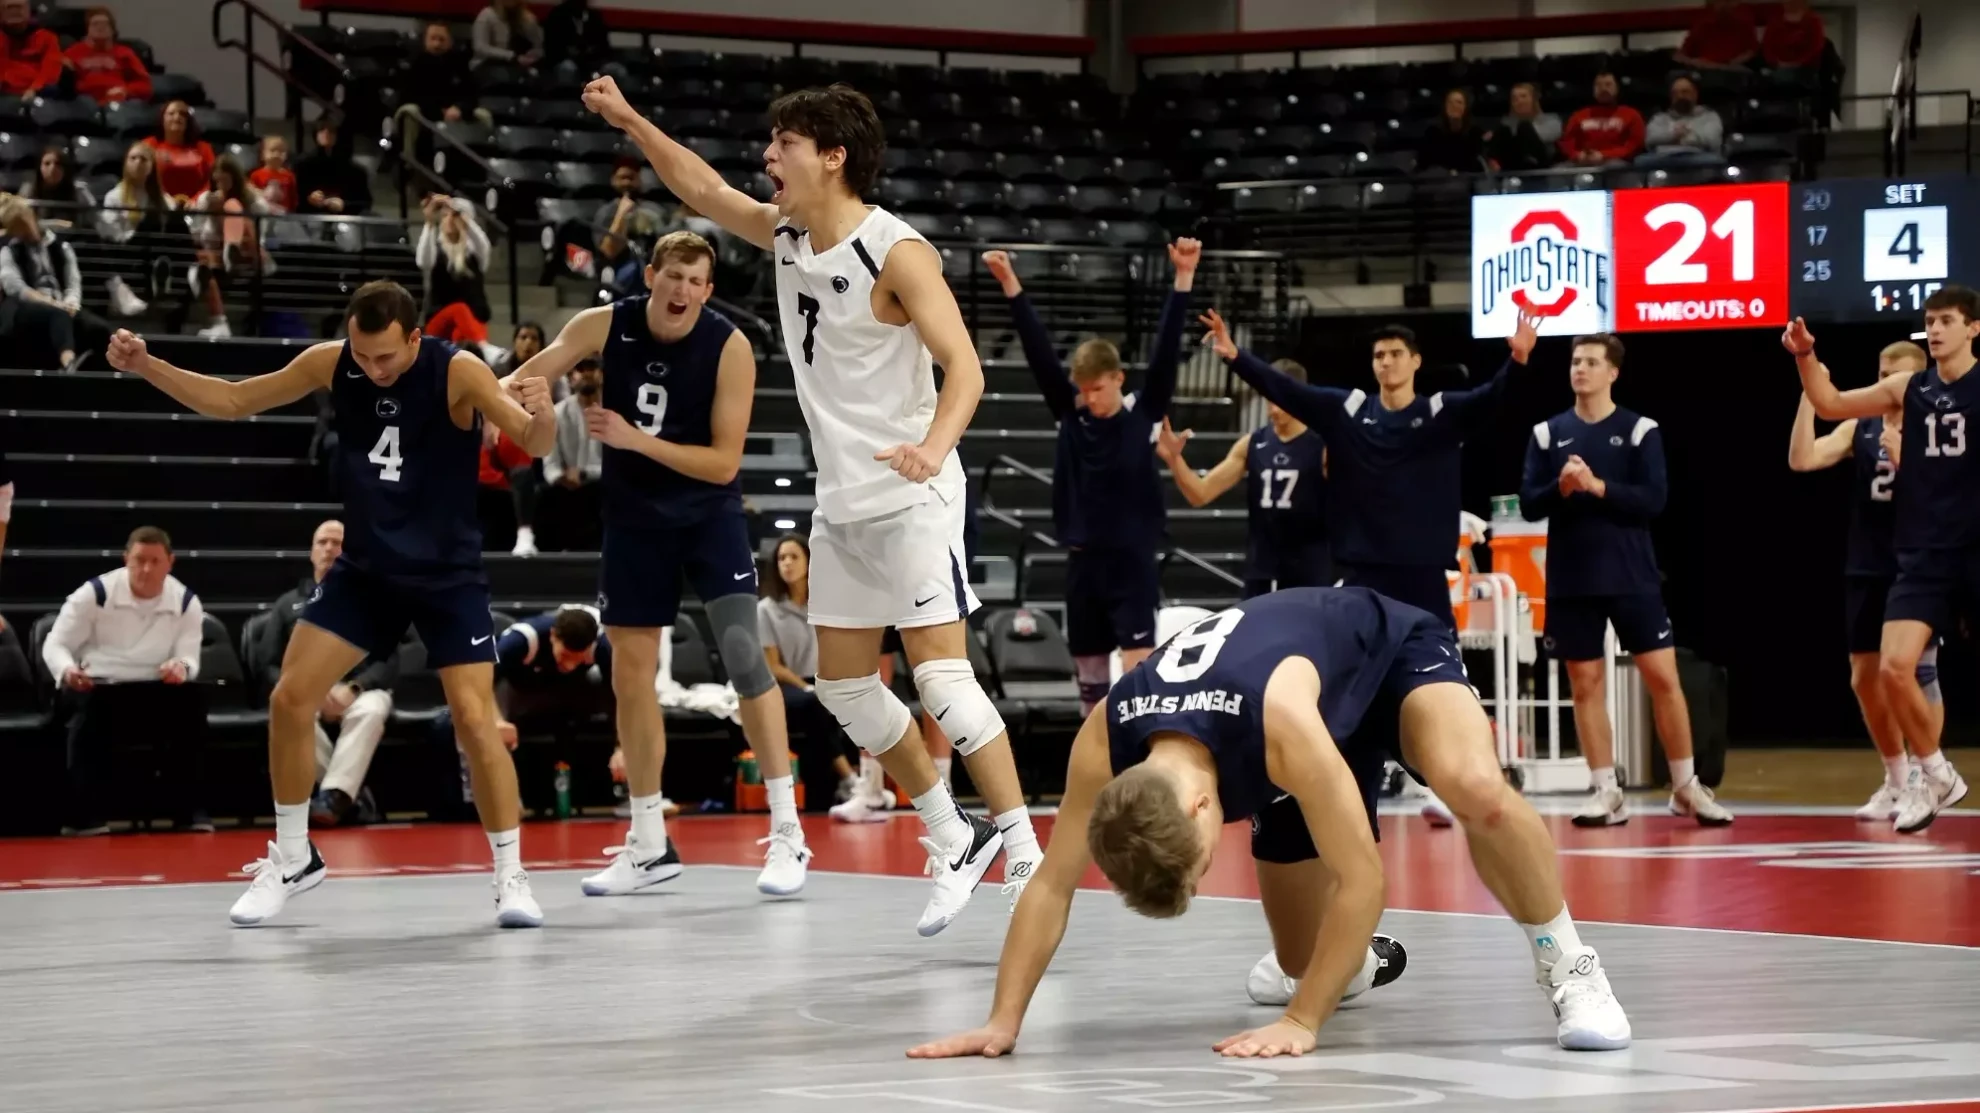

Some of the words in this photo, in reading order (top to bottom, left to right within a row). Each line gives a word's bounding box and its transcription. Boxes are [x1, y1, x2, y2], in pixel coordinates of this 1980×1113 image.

[1802, 190, 1831, 211] 20
[1885, 184, 1927, 204] SET
[1644, 199, 1755, 285] 21
[1806, 225, 1828, 247] 17
[1888, 222, 1925, 265] 4
[1802, 260, 1832, 282] 25
[797, 291, 820, 368] 7
[1636, 299, 1746, 323] TIMEOUTS:
[1749, 298, 1765, 318] 0
[636, 382, 668, 437] 9
[367, 425, 404, 482] 4
[1924, 411, 1966, 457] 13
[1260, 468, 1300, 509] 17
[1155, 608, 1245, 683] 8
[1180, 689, 1243, 716] PENN
